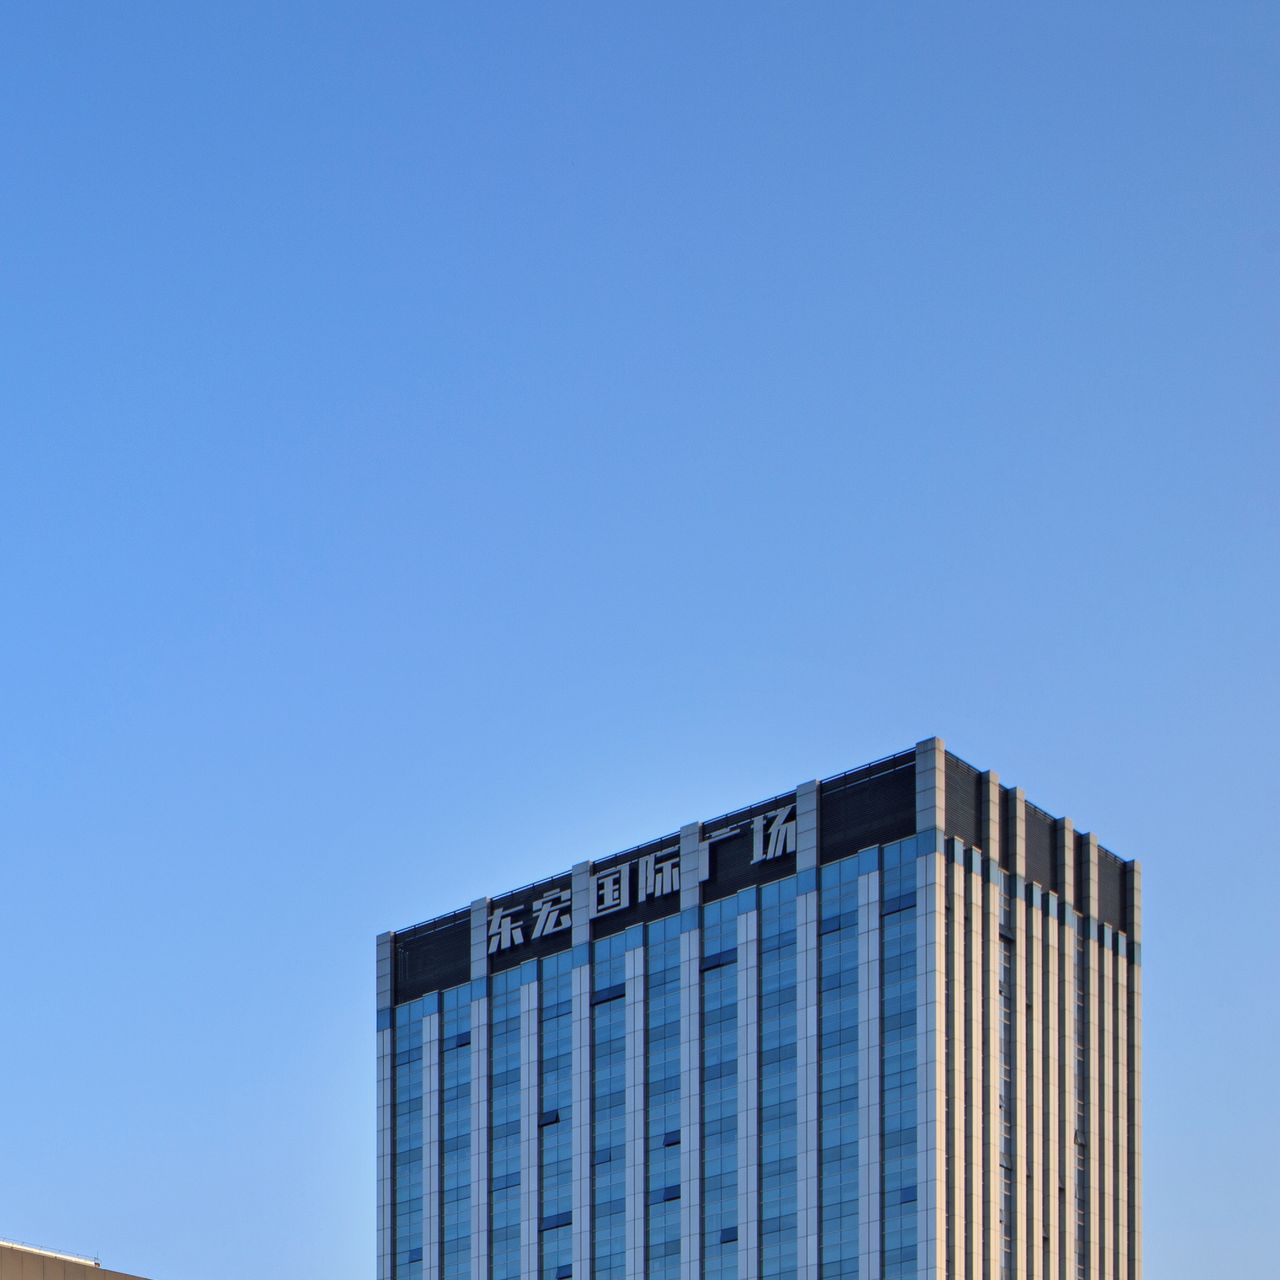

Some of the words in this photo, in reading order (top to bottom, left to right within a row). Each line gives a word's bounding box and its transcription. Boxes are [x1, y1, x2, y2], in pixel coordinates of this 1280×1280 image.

[487, 802, 797, 954] 东宏国际广场
